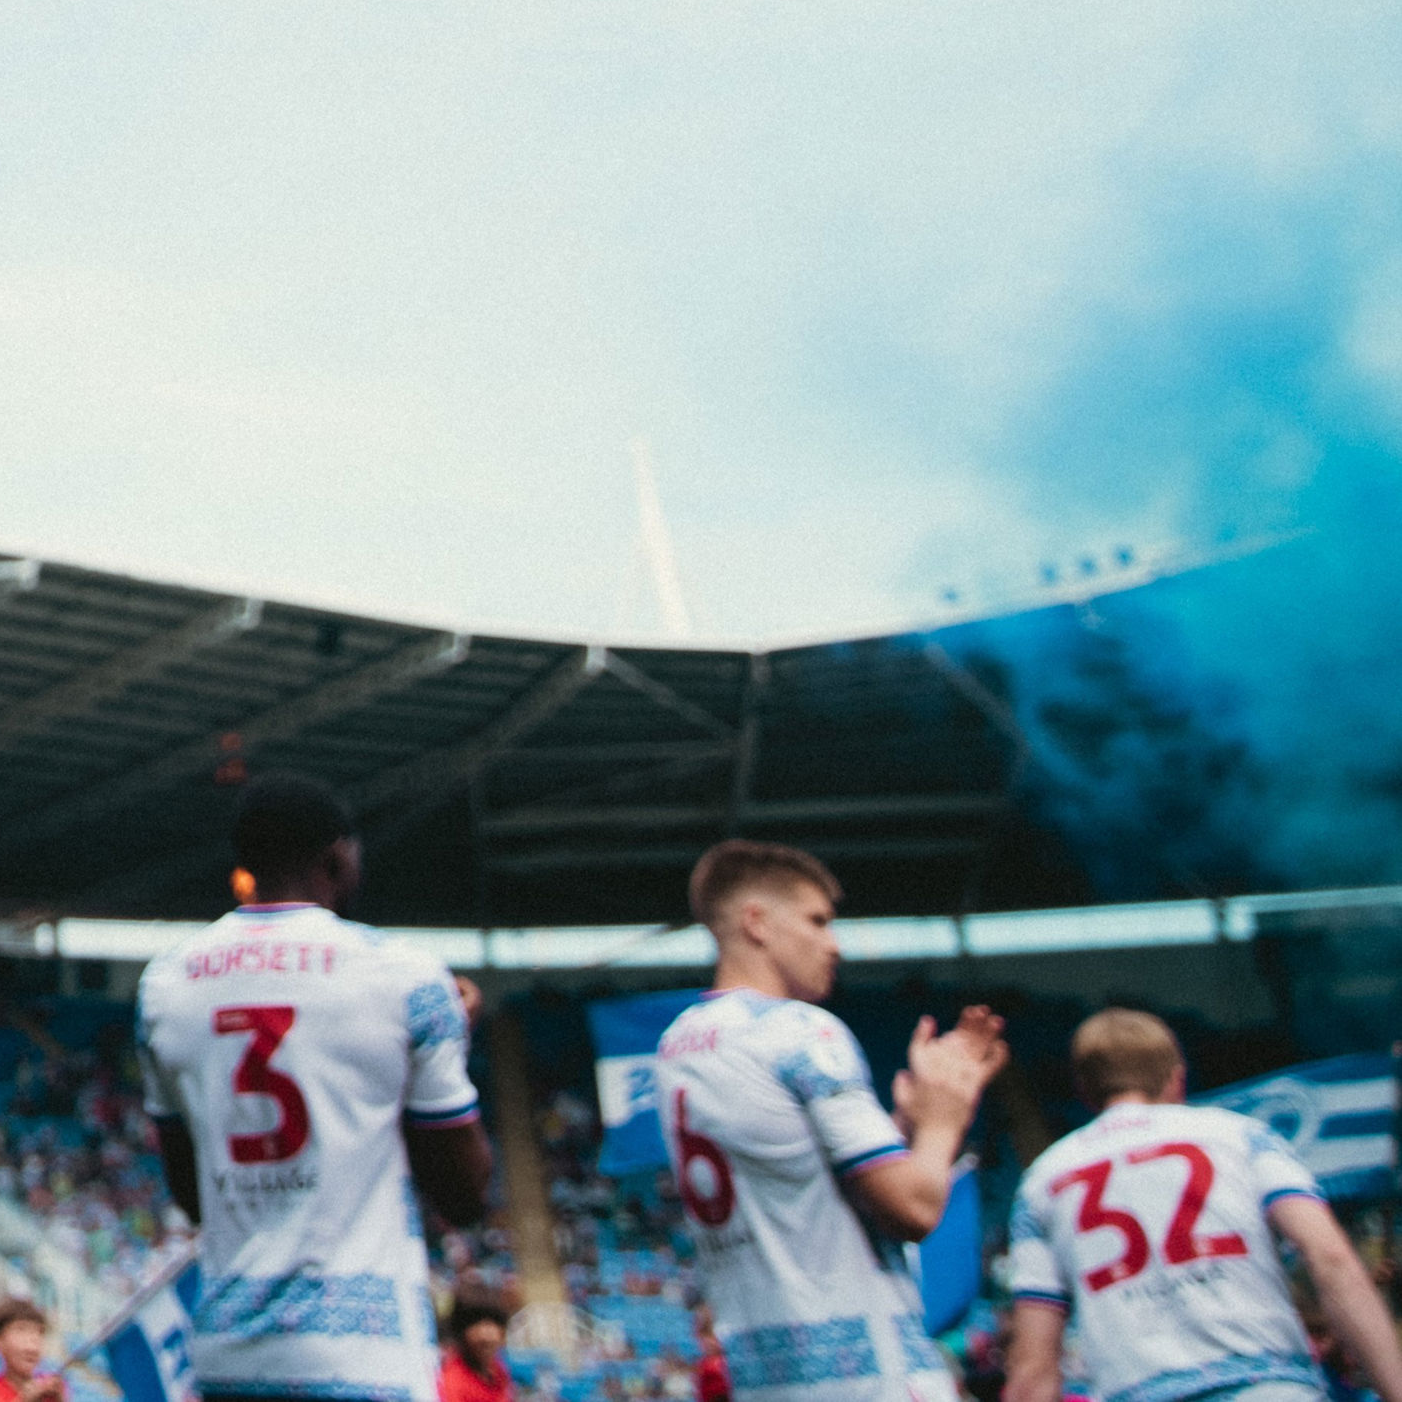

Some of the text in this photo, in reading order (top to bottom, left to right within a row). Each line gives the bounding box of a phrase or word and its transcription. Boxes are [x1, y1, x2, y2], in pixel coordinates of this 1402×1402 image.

[214, 1005, 311, 1164] 3
[673, 1087, 737, 1227] 6
[1048, 1142, 1249, 1292] 32
